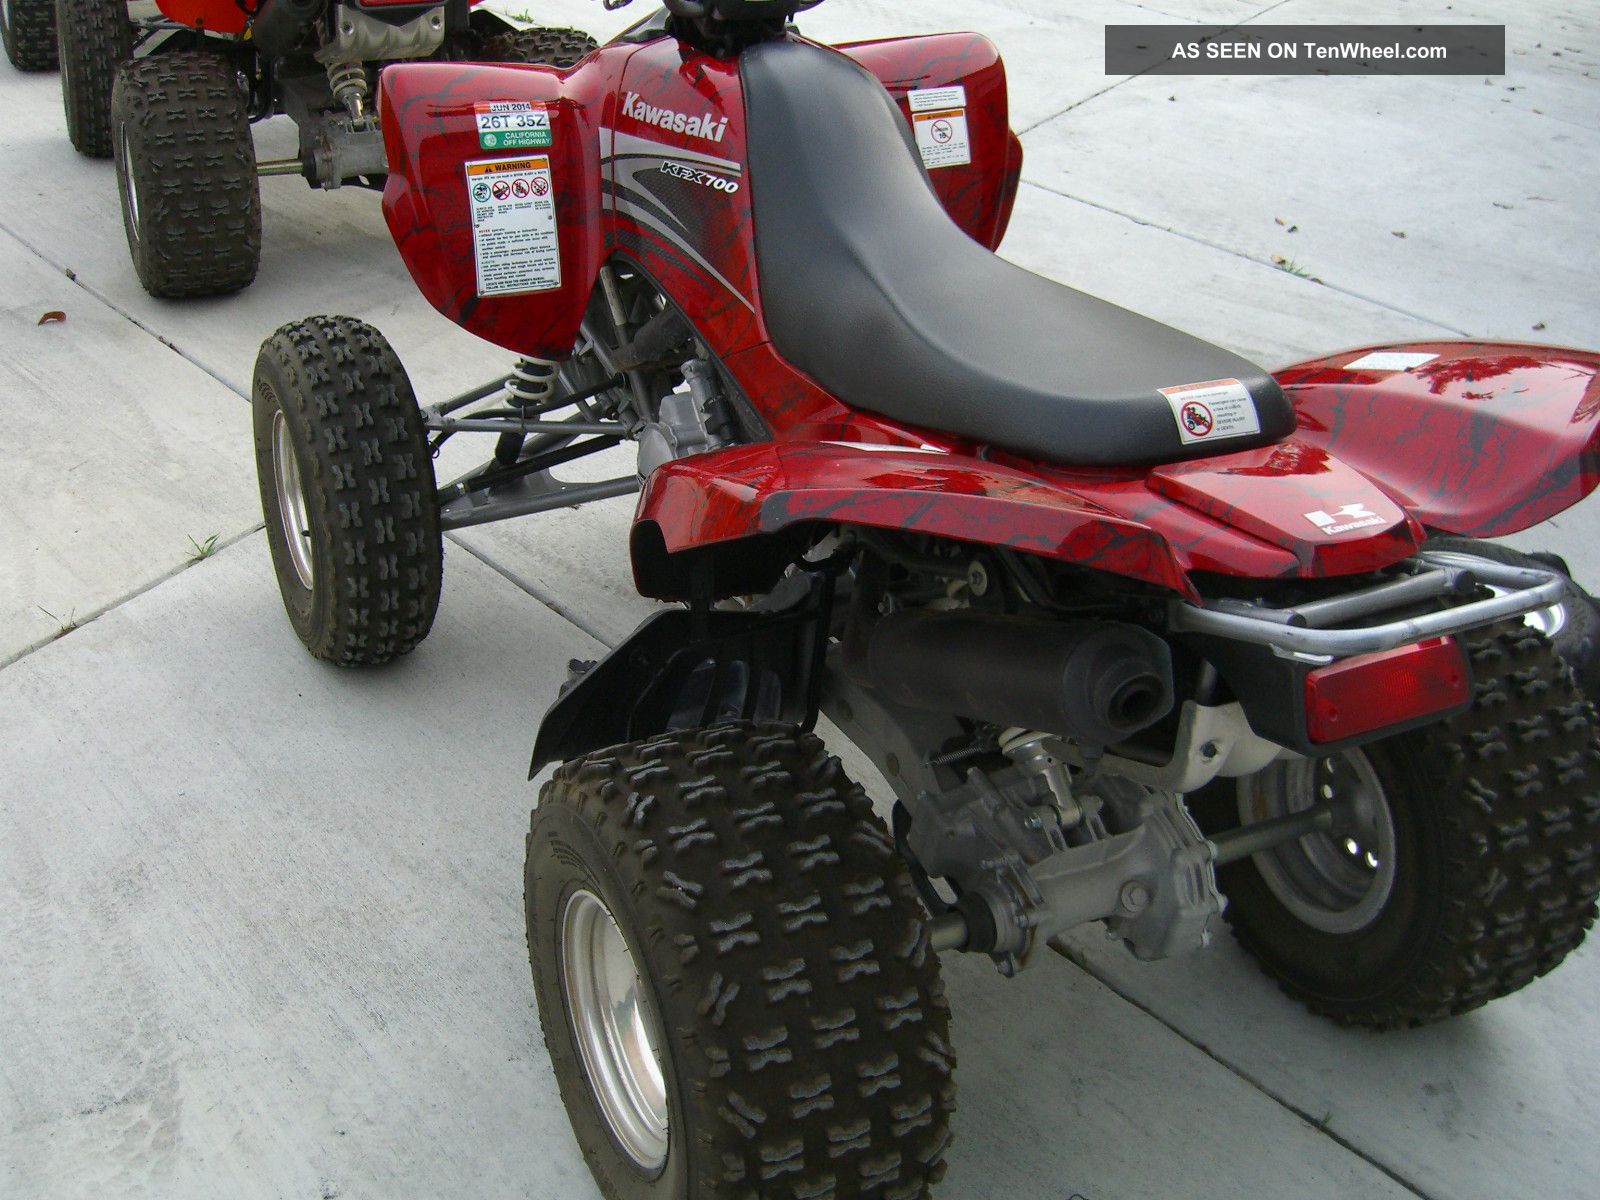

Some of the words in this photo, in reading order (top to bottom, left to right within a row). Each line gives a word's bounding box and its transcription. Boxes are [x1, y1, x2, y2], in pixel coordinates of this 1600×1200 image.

[491, 104, 510, 112] JUN
[511, 103, 531, 111] 2014
[481, 115, 510, 129] 26T
[516, 114, 547, 127] 35Z
[622, 91, 728, 142] Kawasaki
[505, 131, 547, 140] CALIFORNIA
[518, 138, 551, 146] HIGHWAY
[495, 161, 532, 172] WARNING
